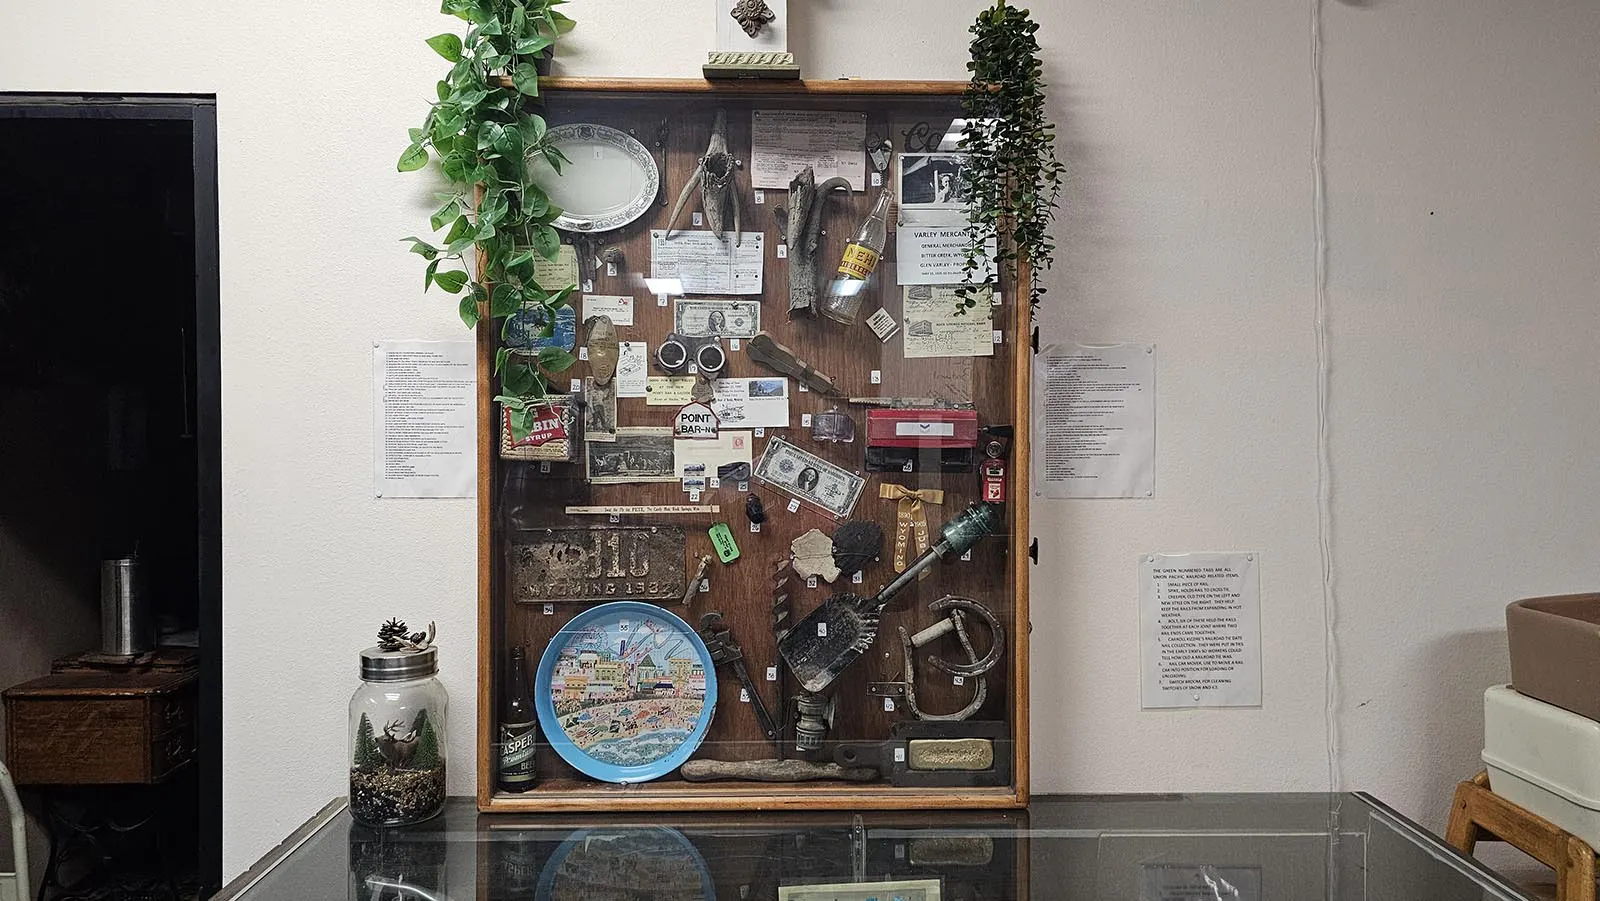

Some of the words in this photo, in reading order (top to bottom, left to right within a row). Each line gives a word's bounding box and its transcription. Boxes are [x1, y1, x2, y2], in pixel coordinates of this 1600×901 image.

[681, 414, 711, 422] POINT
[681, 425, 710, 434] BAR-N
[526, 433, 552, 442] SYRUP
